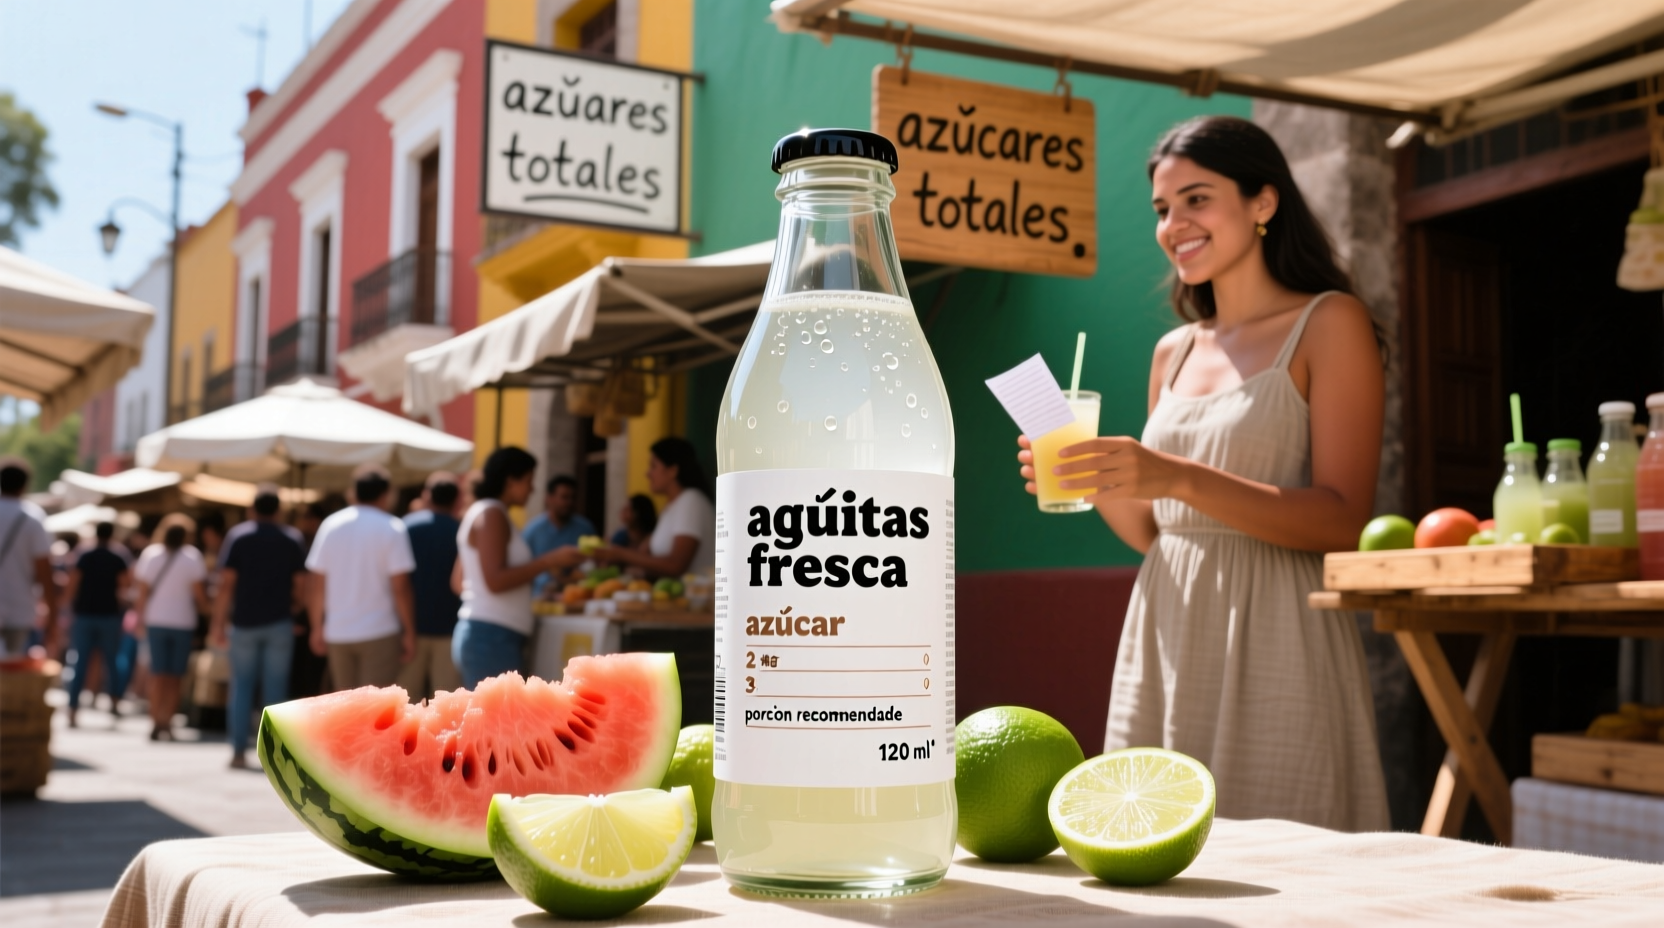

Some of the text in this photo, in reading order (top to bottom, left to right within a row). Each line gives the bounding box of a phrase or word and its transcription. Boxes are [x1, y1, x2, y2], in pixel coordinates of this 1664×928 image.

[501, 132, 661, 200] totales
[747, 542, 908, 588] fresca
[745, 651, 757, 669] 2
[878, 742, 910, 761] 120
